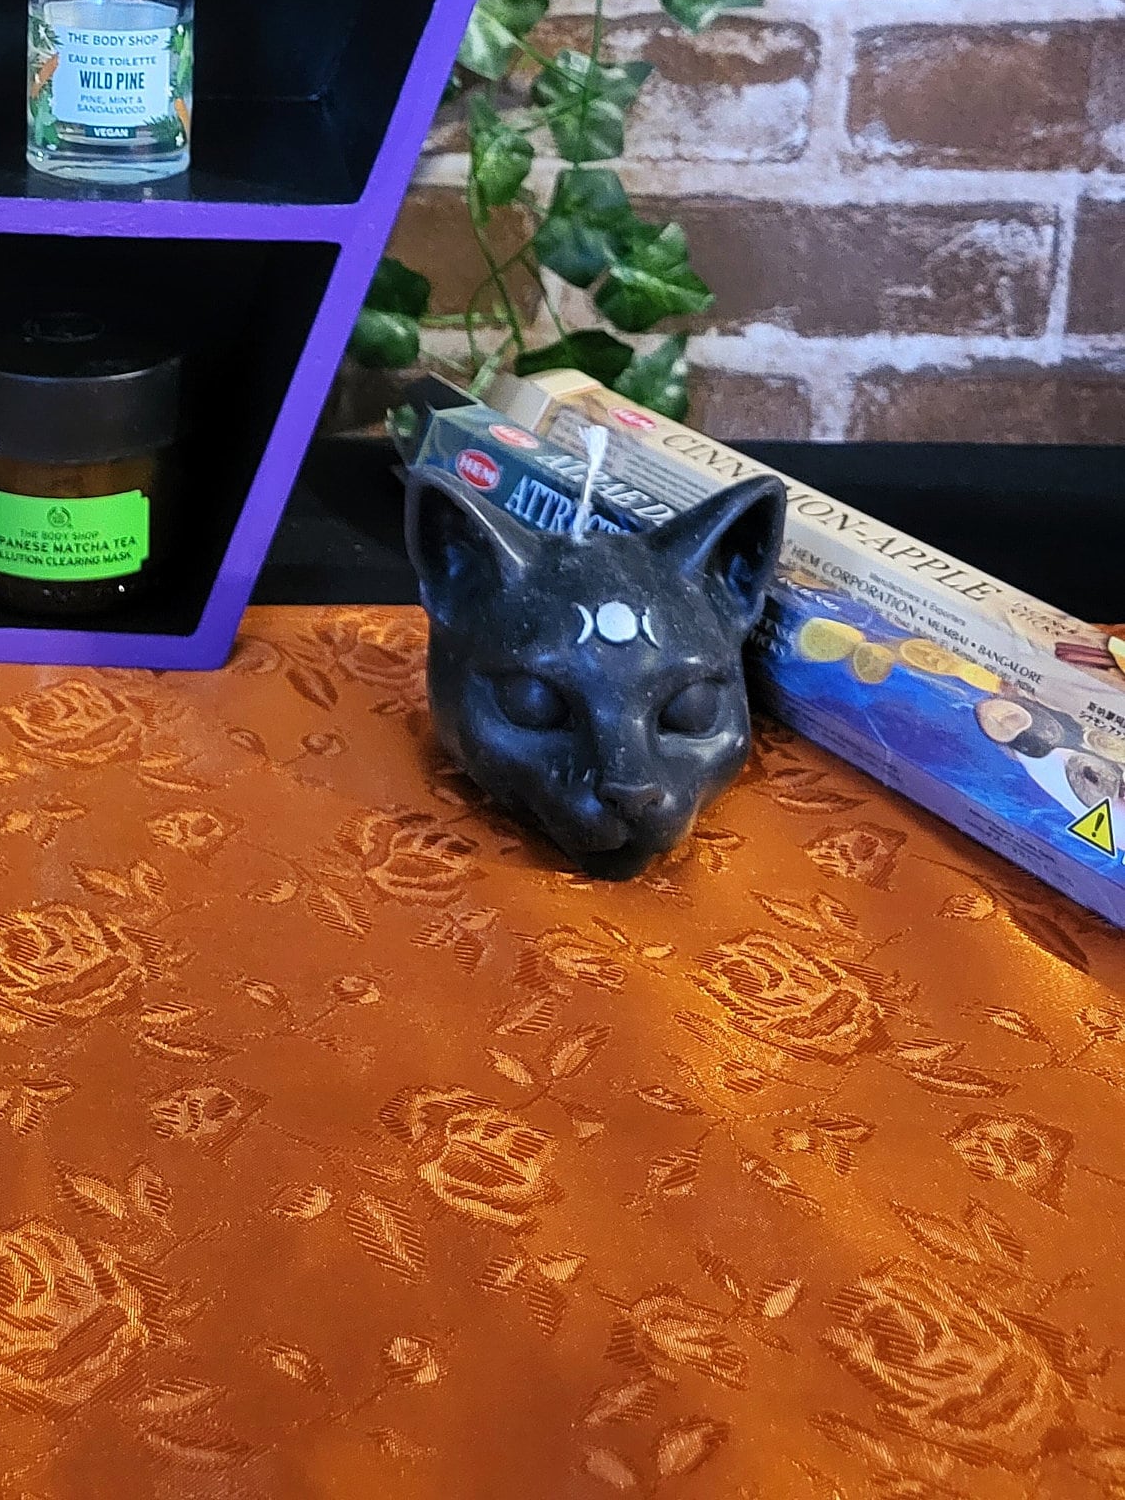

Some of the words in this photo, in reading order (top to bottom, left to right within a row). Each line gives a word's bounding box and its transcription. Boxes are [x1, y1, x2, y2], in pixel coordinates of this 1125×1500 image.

[68, 33, 88, 44] THE
[93, 35, 125, 46] BODY
[129, 34, 159, 46] SHOP
[68, 54, 88, 64] EAU
[91, 55, 104, 65] DE
[109, 55, 157, 66] TOILETTE
[79, 70, 113, 89] WILD
[116, 71, 145, 90] PINE
[80, 94, 106, 105] PINE,
[109, 95, 134, 105] MINT
[77, 104, 146, 115] SANDALWOOD
[93, 127, 129, 137] VEGAN
[663, 432, 1003, 602] CINNON-APPLE
[21, 528, 37, 539] THE
[41, 530, 68, 541] BODY
[72, 530, 99, 541] SHOP
[53, 540, 109, 553] MATCHA
[113, 535, 137, 548] TEA
[46, 555, 101, 567] CLEARING
[102, 551, 134, 564] MASK
[822, 561, 917, 618] CORPORATION
[928, 616, 969, 646] MUMBAI
[978, 644, 1044, 684] BANGALORE
